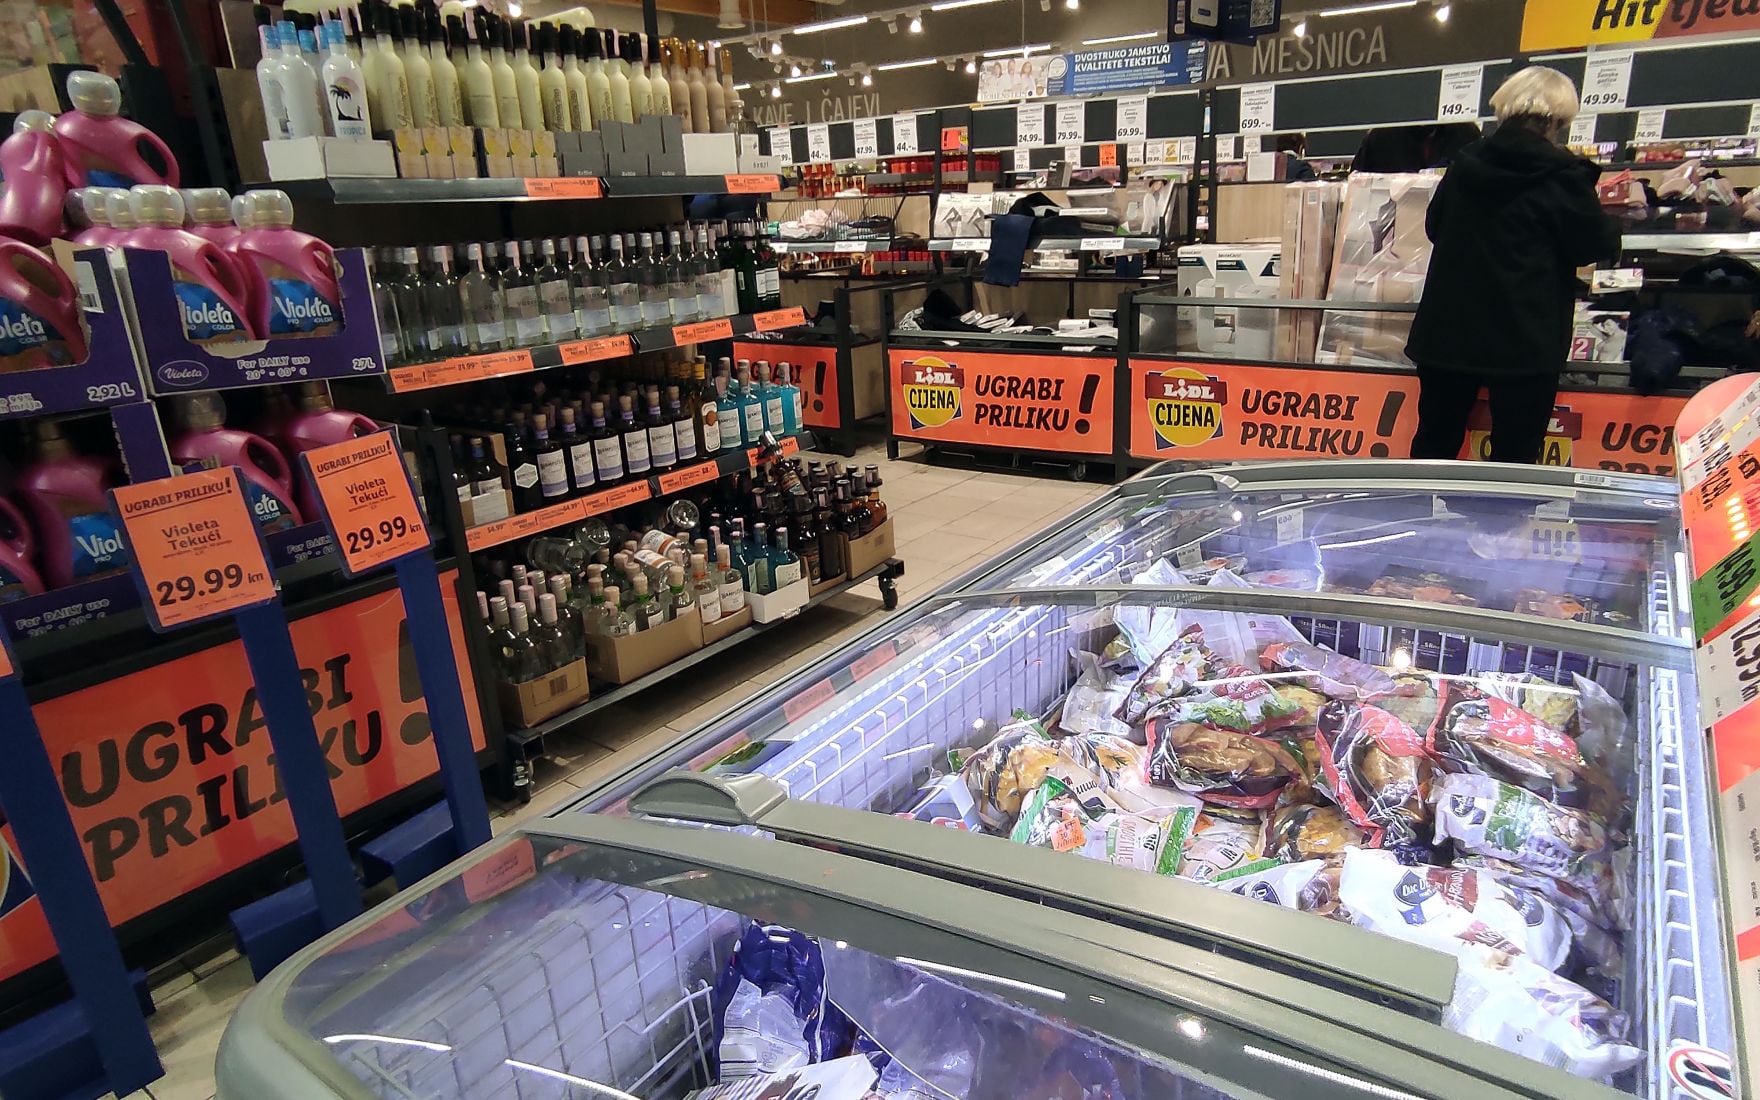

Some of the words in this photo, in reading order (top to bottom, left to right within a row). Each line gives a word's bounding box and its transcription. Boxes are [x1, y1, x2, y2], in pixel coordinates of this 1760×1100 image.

[1075, 47, 1126, 62] DVOSTRUKO
[1127, 44, 1170, 57] JAMSTVO
[1252, 26, 1387, 76] MESNICA
[1075, 60, 1123, 73] KVALITETE
[753, 103, 792, 126] KAVE
[821, 88, 880, 123] ČAJEVI
[1584, 93, 1618, 106] 49.99
[1118, 128, 1140, 137] 69.99
[1242, 118, 1265, 129] 699.-
[1058, 131, 1078, 140] 79.99
[1574, 338, 1589, 354] 2
[237, 359, 257, 370] For
[258, 355, 291, 368] DAILY
[164, 367, 203, 380] Violeta
[909, 388, 955, 409] CIJENA
[975, 374, 1065, 402] UGRABI
[1155, 402, 1215, 428] CIJENA
[1240, 388, 1360, 421] UGRABI
[974, 403, 1071, 432] PRILIKU
[1240, 421, 1364, 457] PRILIKU
[317, 457, 351, 473] UGRABI
[352, 439, 393, 462] PRILIKU!
[124, 493, 173, 513] UGRABI
[176, 477, 233, 501] PRILIKU!
[345, 476, 386, 495] Violeta
[351, 487, 389, 506] Tekući
[161, 518, 220, 539] Violeta
[346, 516, 407, 555] 29.99
[409, 523, 422, 534] kn
[168, 529, 222, 551] Tekući
[156, 563, 243, 607] 29.99
[248, 572, 264, 584] kn
[43, 603, 84, 623] DAILY
